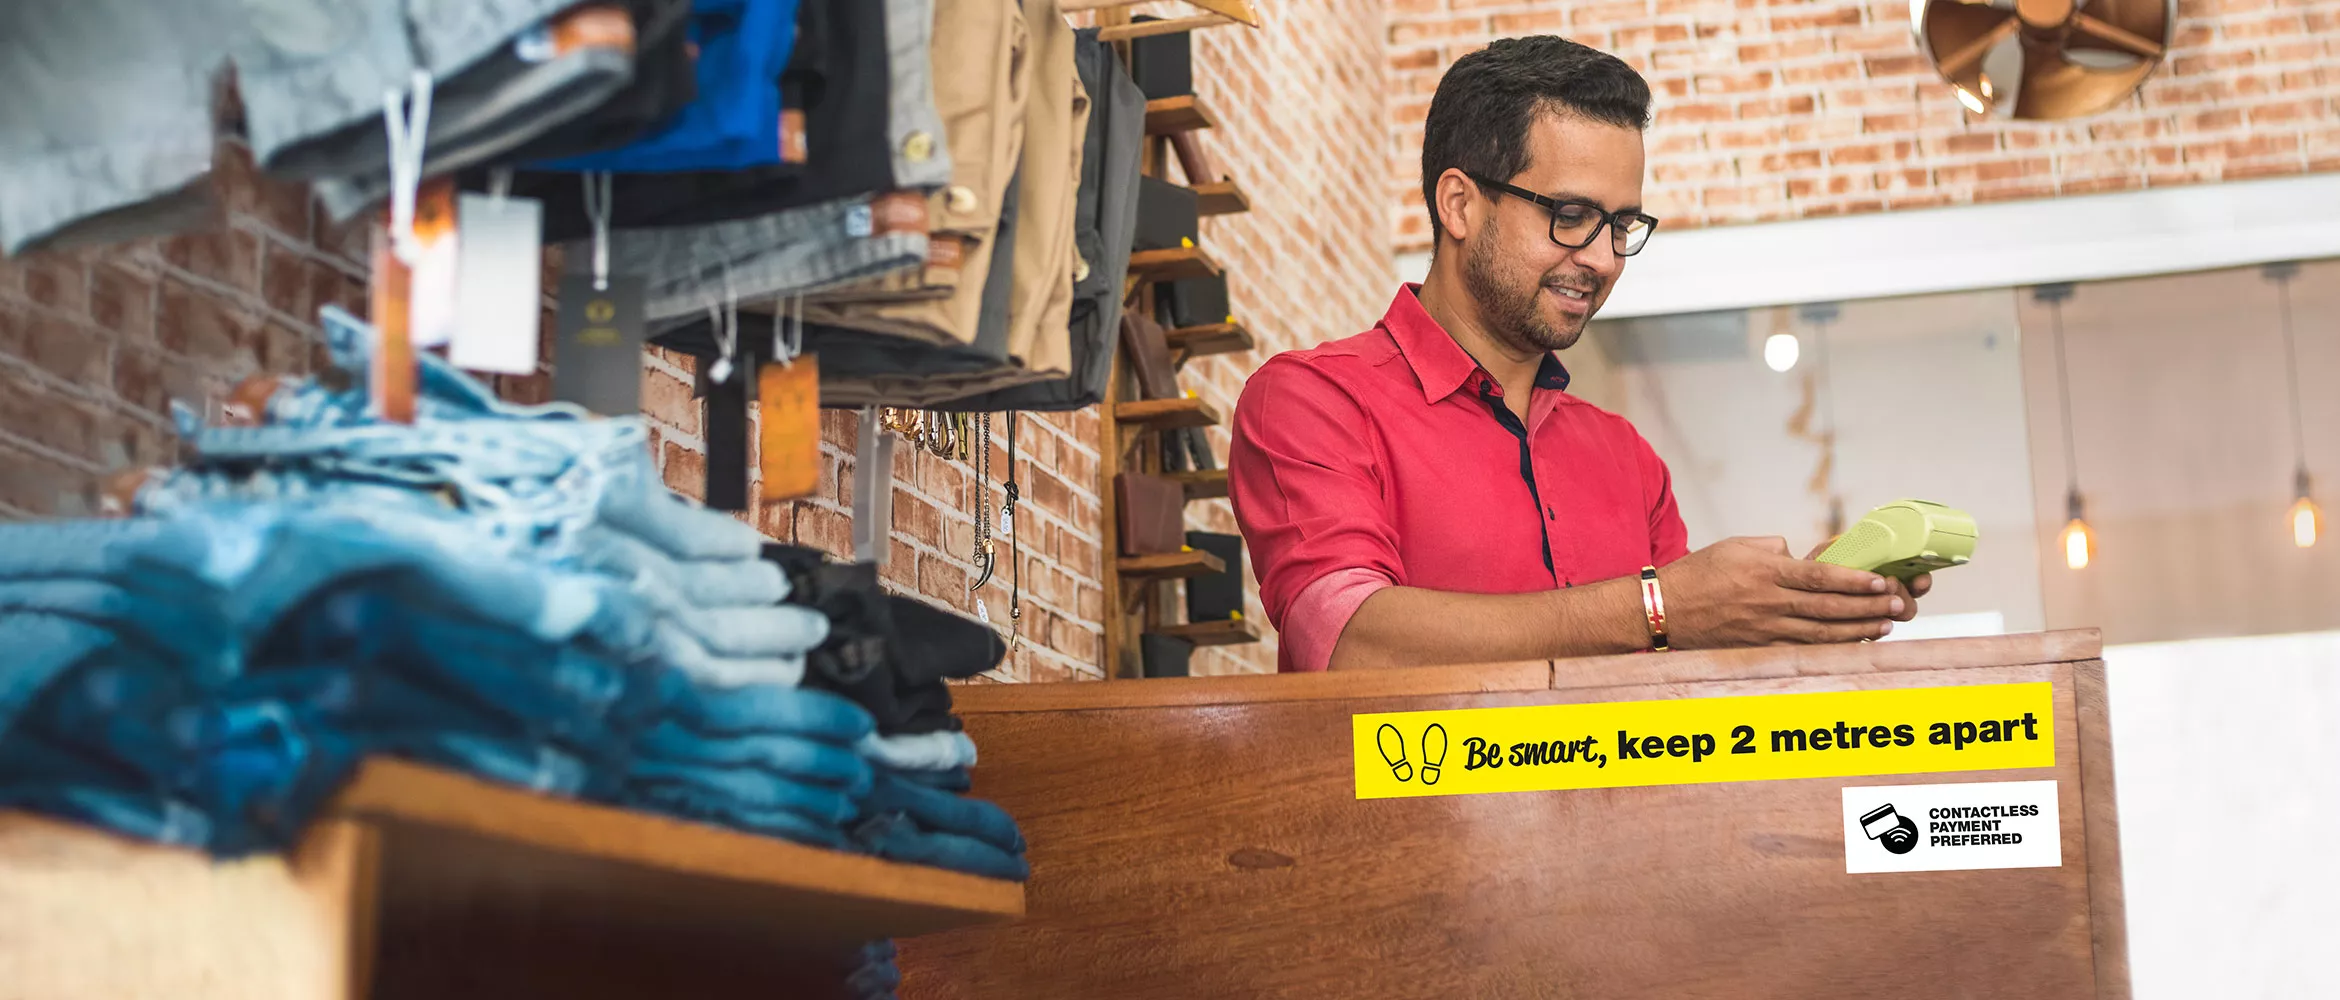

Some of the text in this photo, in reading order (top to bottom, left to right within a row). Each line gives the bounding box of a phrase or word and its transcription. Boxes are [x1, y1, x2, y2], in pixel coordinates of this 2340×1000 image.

[1462, 712, 2039, 771] Be smart, keep 2 metres apart
[1928, 804, 2039, 820] CONTACTLESS
[1929, 819, 2002, 834] PAYMENT
[1930, 832, 2023, 847] PREFERRED
